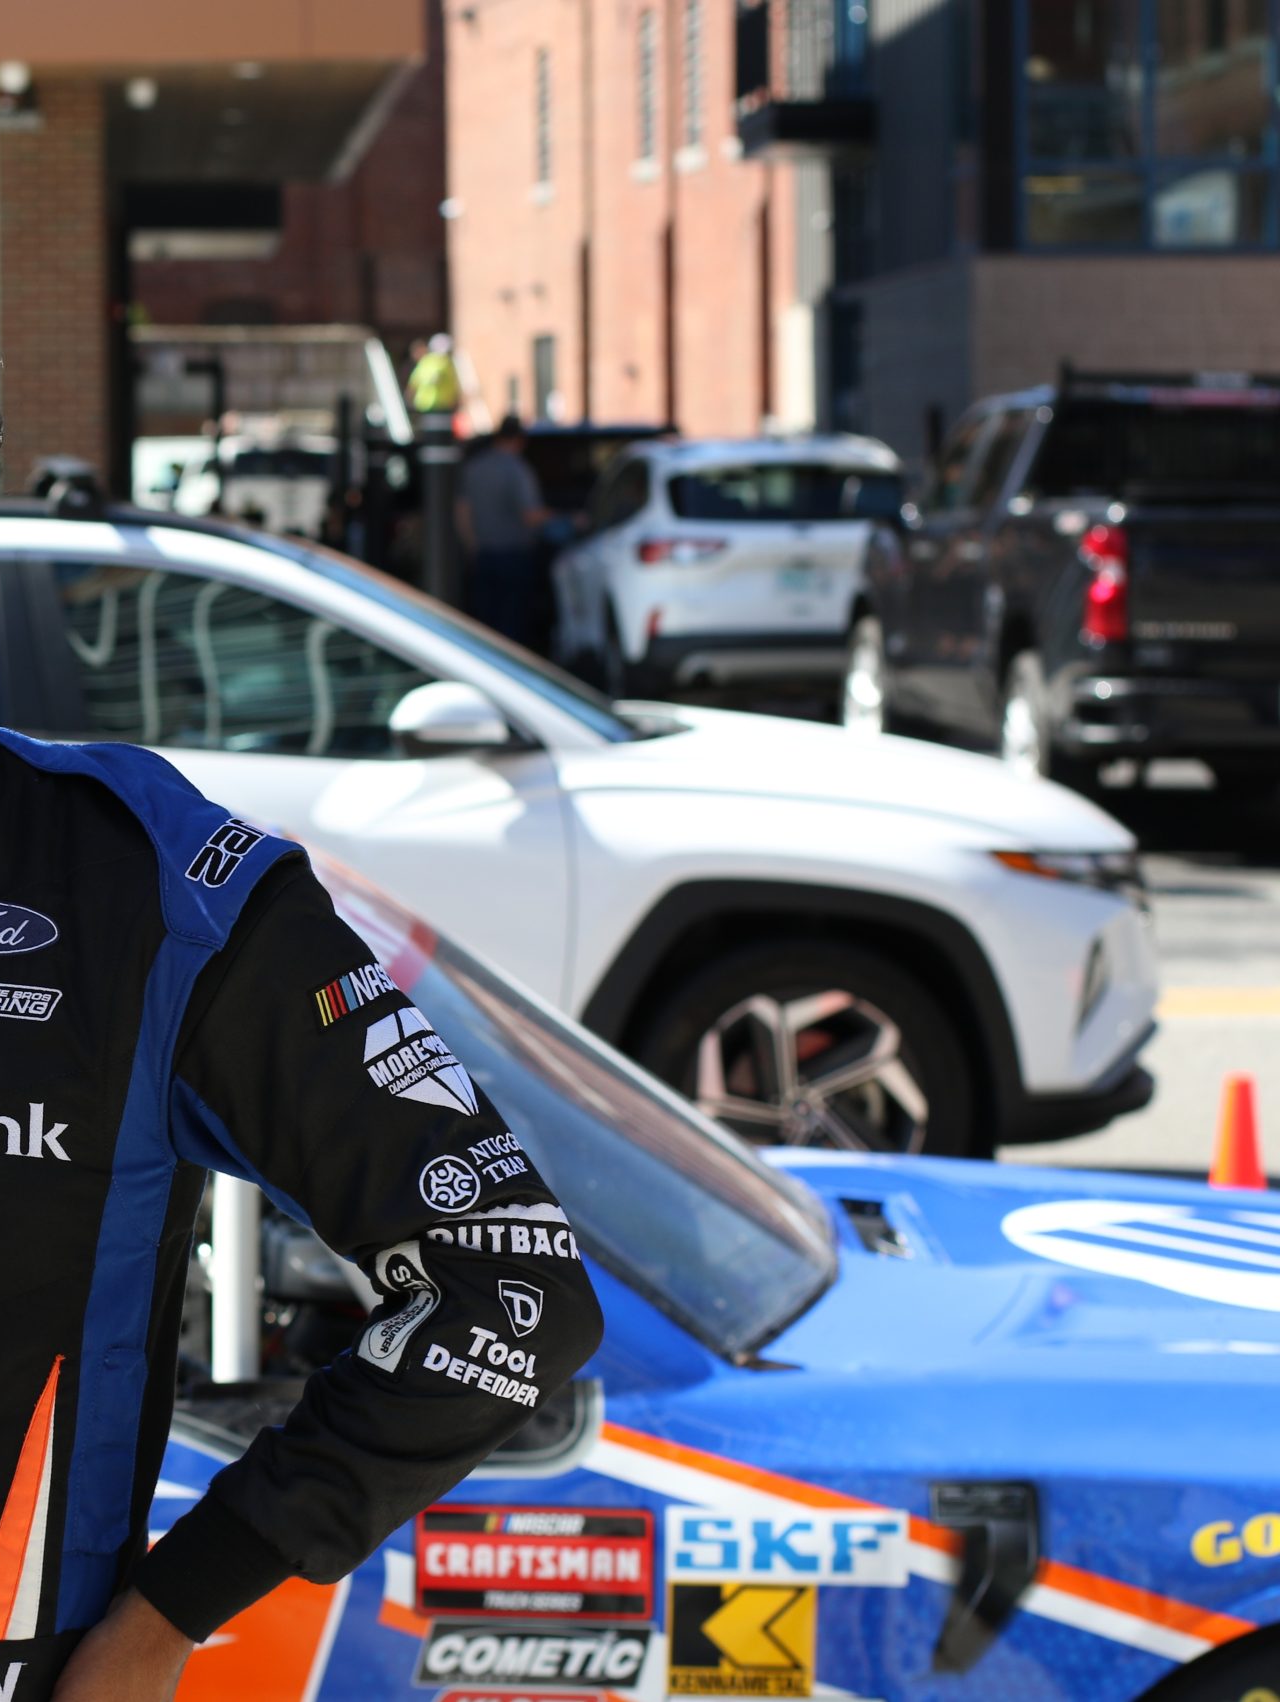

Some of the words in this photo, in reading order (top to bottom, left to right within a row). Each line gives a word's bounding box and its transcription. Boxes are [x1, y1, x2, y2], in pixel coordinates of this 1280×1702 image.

[12, 991, 52, 1002] BROS
[349, 962, 400, 1007] NAS
[482, 1156, 529, 1184] TRAP
[425, 1542, 641, 1582] CRAFTSMAN
[675, 1518, 899, 1573] SKF
